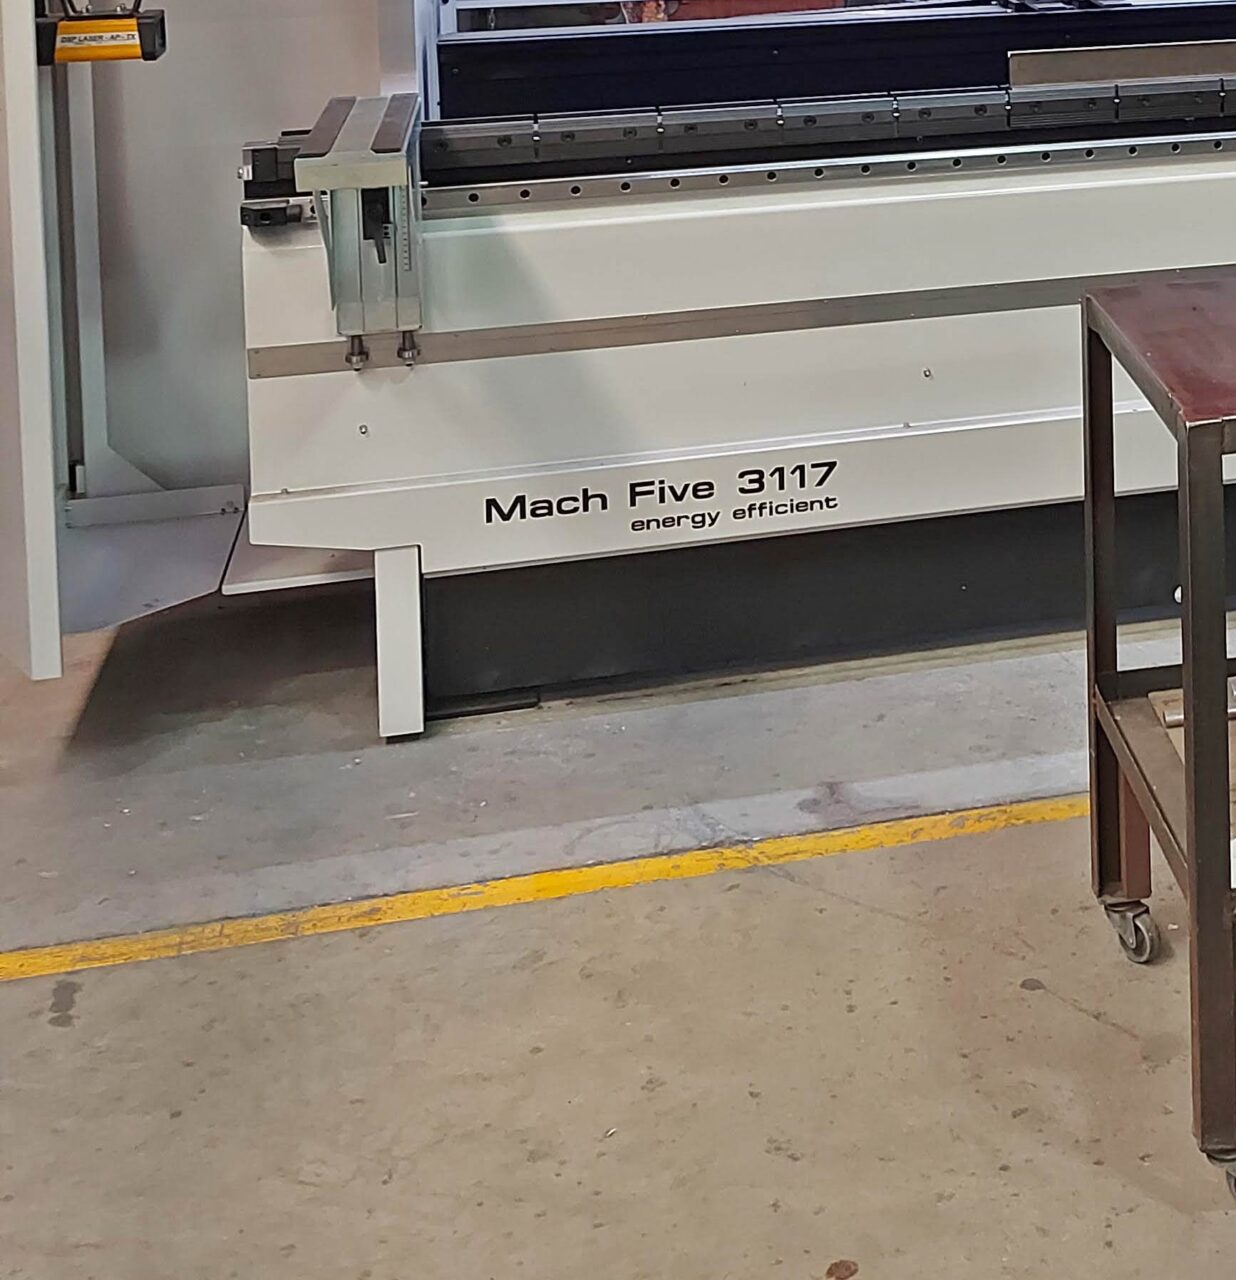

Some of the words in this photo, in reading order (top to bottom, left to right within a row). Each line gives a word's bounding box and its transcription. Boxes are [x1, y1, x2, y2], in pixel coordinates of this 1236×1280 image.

[484, 486, 609, 524] Mach
[629, 478, 716, 508] Five
[737, 460, 839, 495] 3117
[630, 511, 722, 533] energy
[732, 495, 839, 520] efficient
